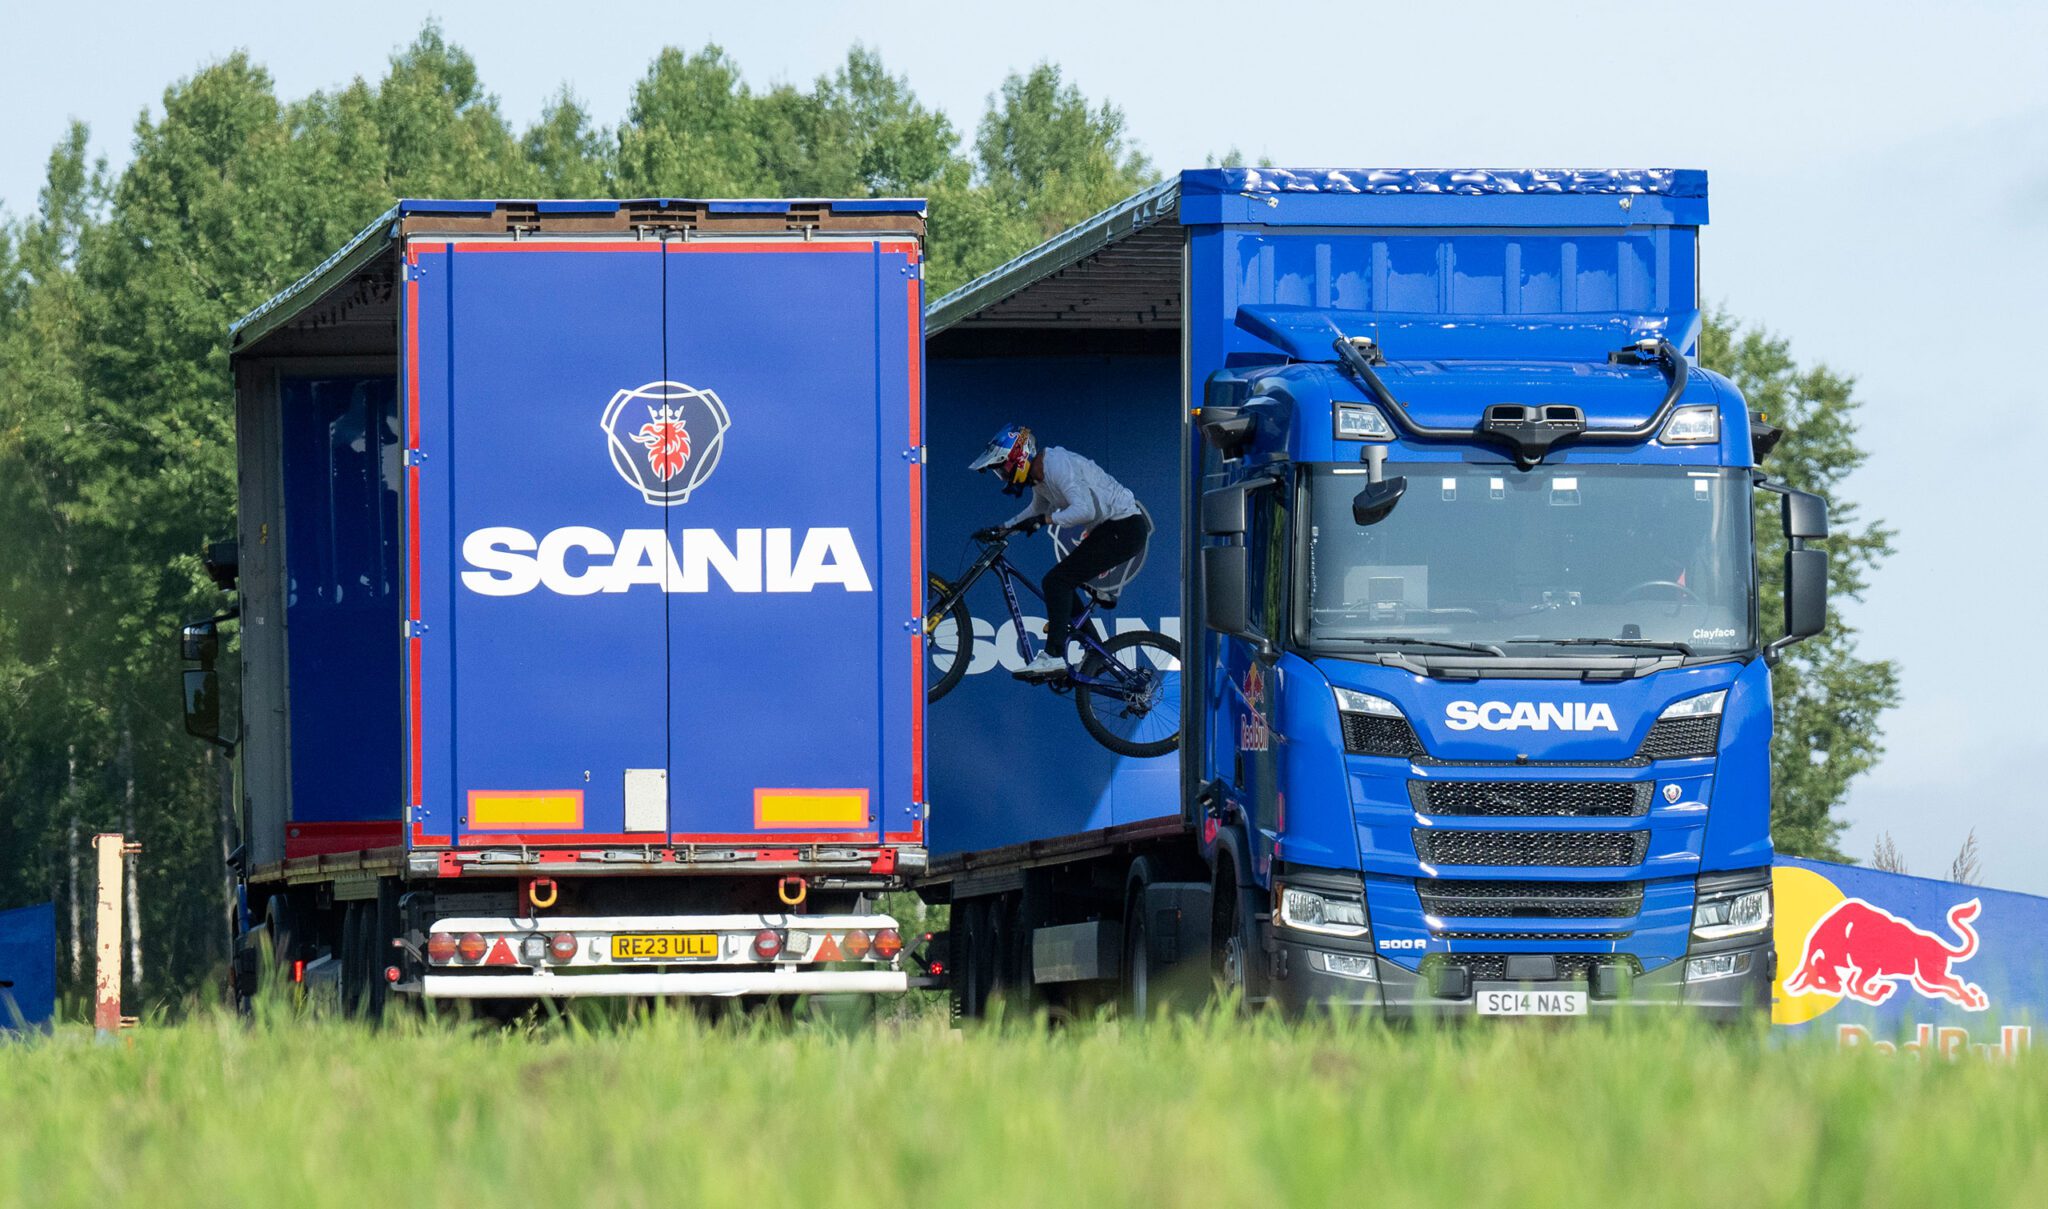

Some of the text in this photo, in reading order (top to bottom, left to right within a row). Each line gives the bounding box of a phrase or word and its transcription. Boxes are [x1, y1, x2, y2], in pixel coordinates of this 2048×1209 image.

[461, 526, 872, 597] SCANIA
[1693, 628, 1735, 640] Clayface
[1445, 701, 1619, 731] SCANIA
[619, 937, 711, 955] RE23 ULL
[1379, 939, 1413, 949] 500
[1538, 994, 1575, 1012] NAS
